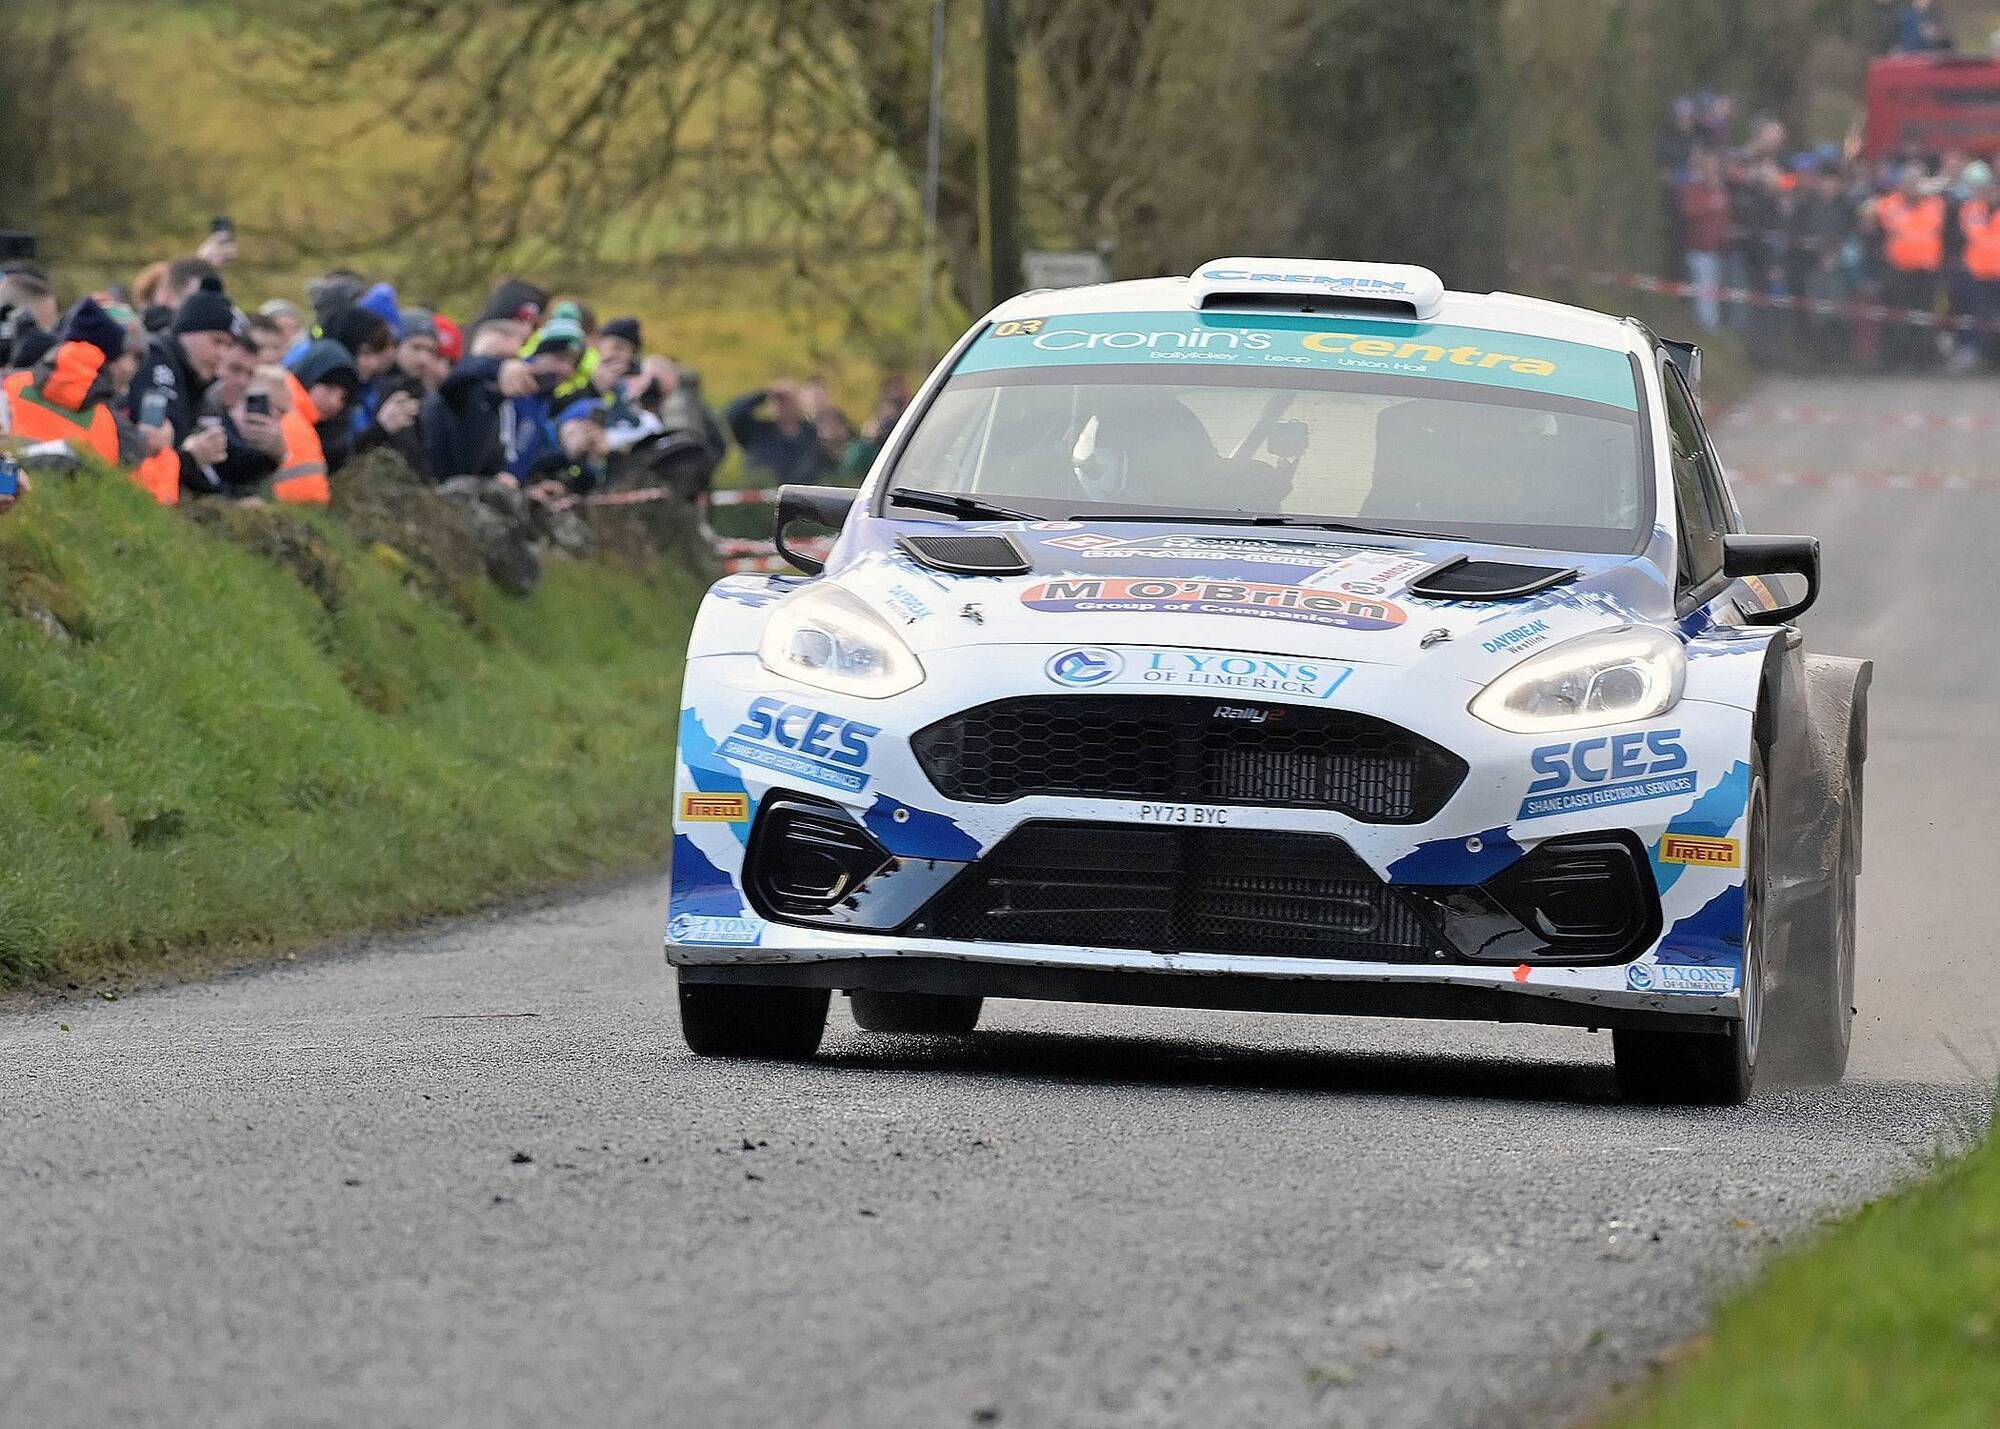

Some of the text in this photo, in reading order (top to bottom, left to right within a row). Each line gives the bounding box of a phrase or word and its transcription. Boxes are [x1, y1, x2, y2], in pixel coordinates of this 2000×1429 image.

[994, 319, 1043, 337] 03
[1032, 327, 1558, 376] Cronin's Centra
[1264, 354, 1312, 365] Leap
[1338, 358, 1389, 370] Union
[1394, 361, 1427, 373] Hall
[1044, 581, 1387, 620] M O'Brien
[1075, 601, 1349, 626] Group of Companies
[1481, 619, 1551, 654] DAYBREAK
[1149, 653, 1319, 683] LYONS
[1143, 670, 1316, 695] OF LIMERICK
[734, 696, 881, 768] SCES
[1527, 729, 1688, 794] SCES
[687, 798, 743, 816] PIRELLI
[1527, 777, 1692, 814] SHANE CASEY ELECTRICAL SERVICES
[1141, 805, 1228, 824] PY73 BYC
[1666, 839, 1733, 862] PIRELLI
[1662, 967, 1728, 982] LYONS
